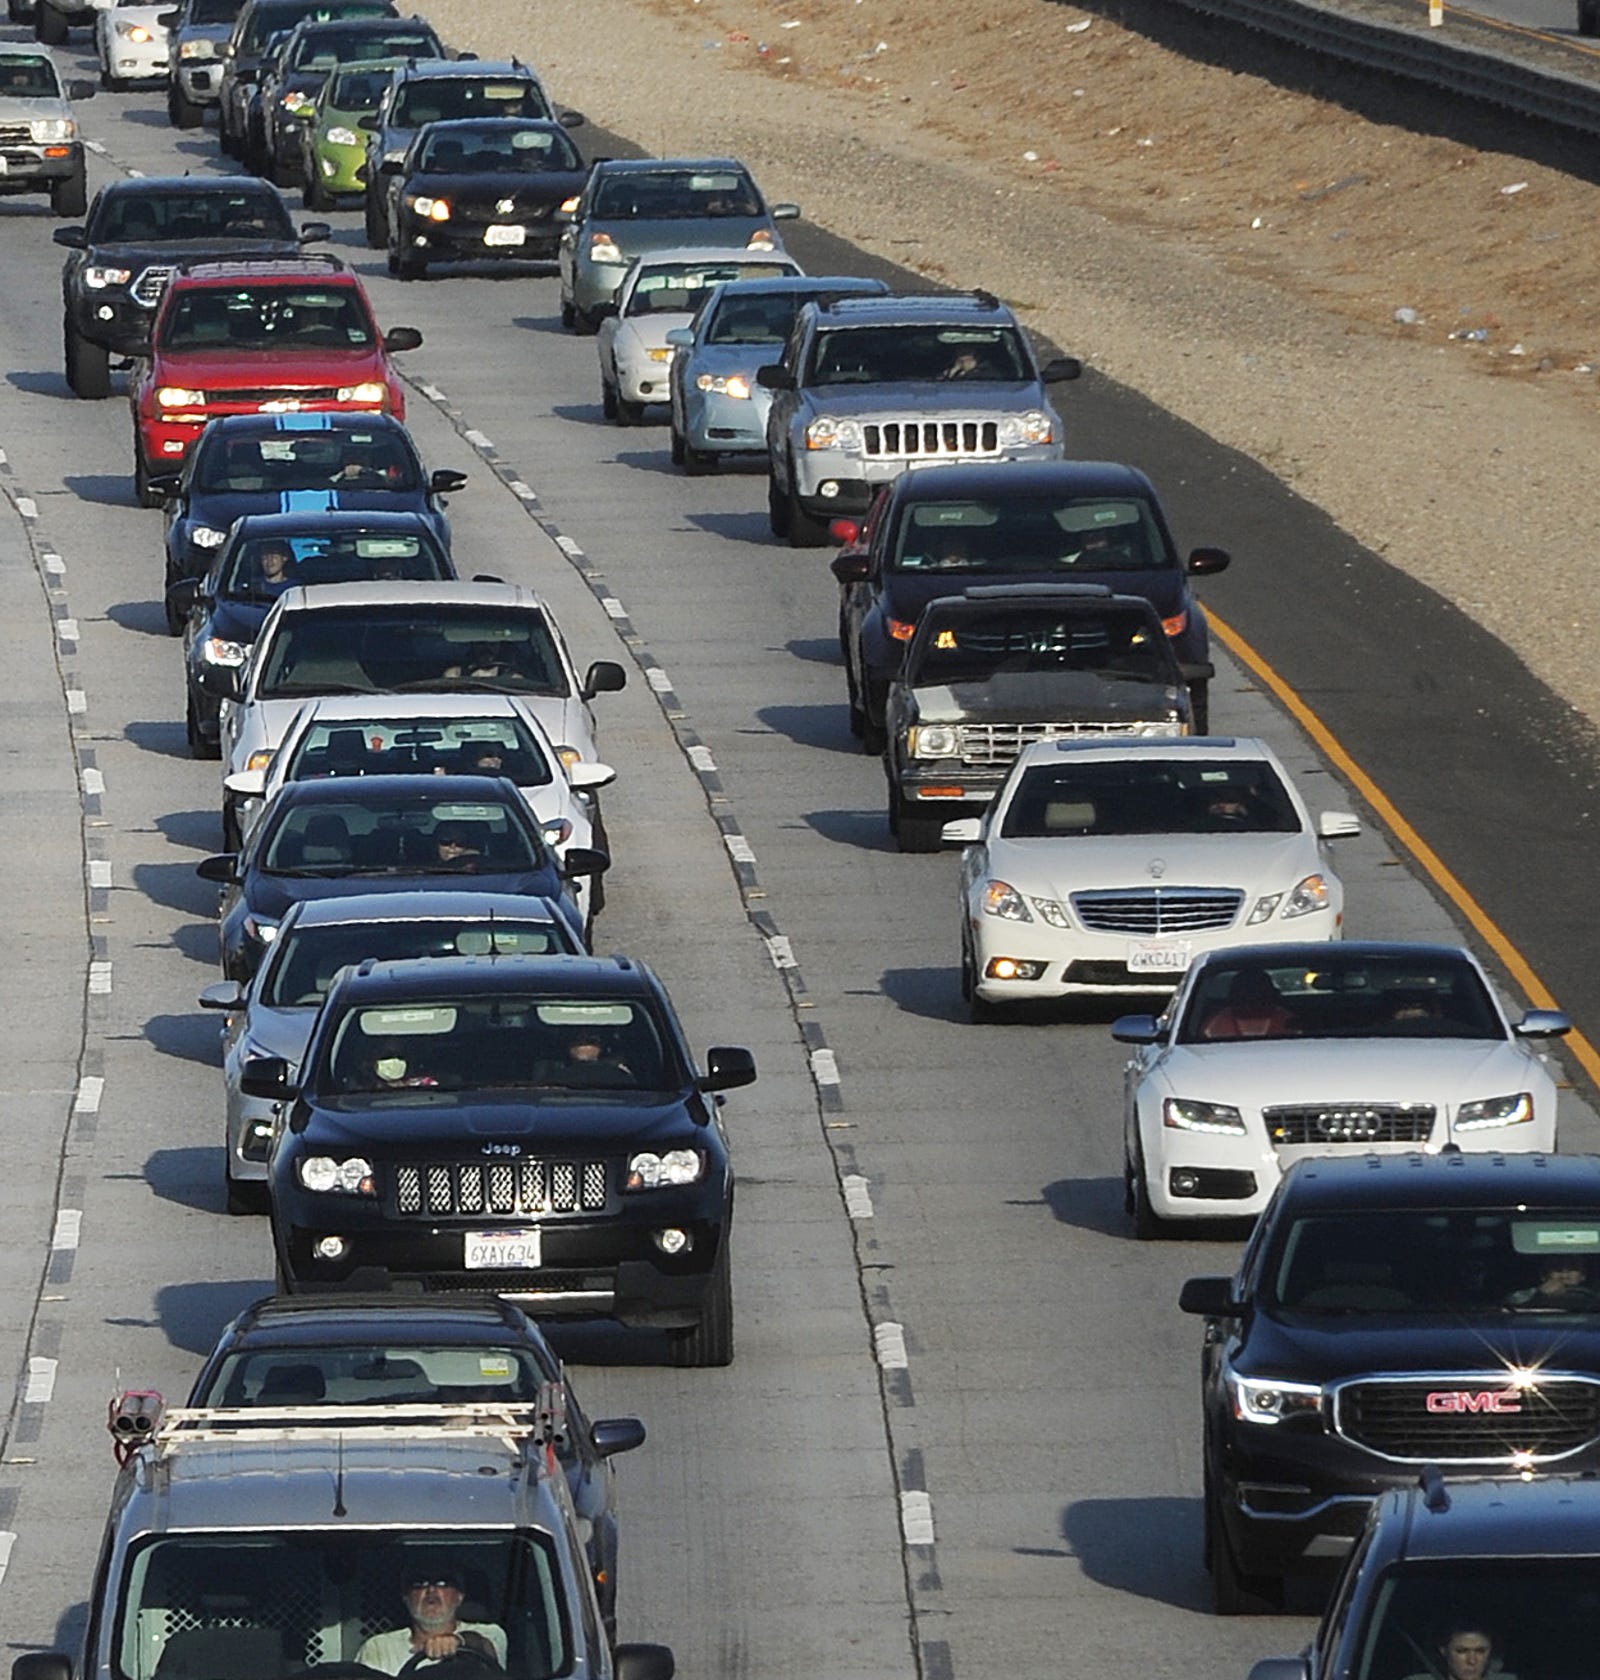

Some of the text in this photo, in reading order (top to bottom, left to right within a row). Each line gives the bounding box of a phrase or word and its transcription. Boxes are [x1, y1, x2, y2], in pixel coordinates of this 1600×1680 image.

[481, 1142, 521, 1156] Jeep
[470, 1244, 535, 1265] 6XAY634
[1426, 1391, 1522, 1413] GMC
